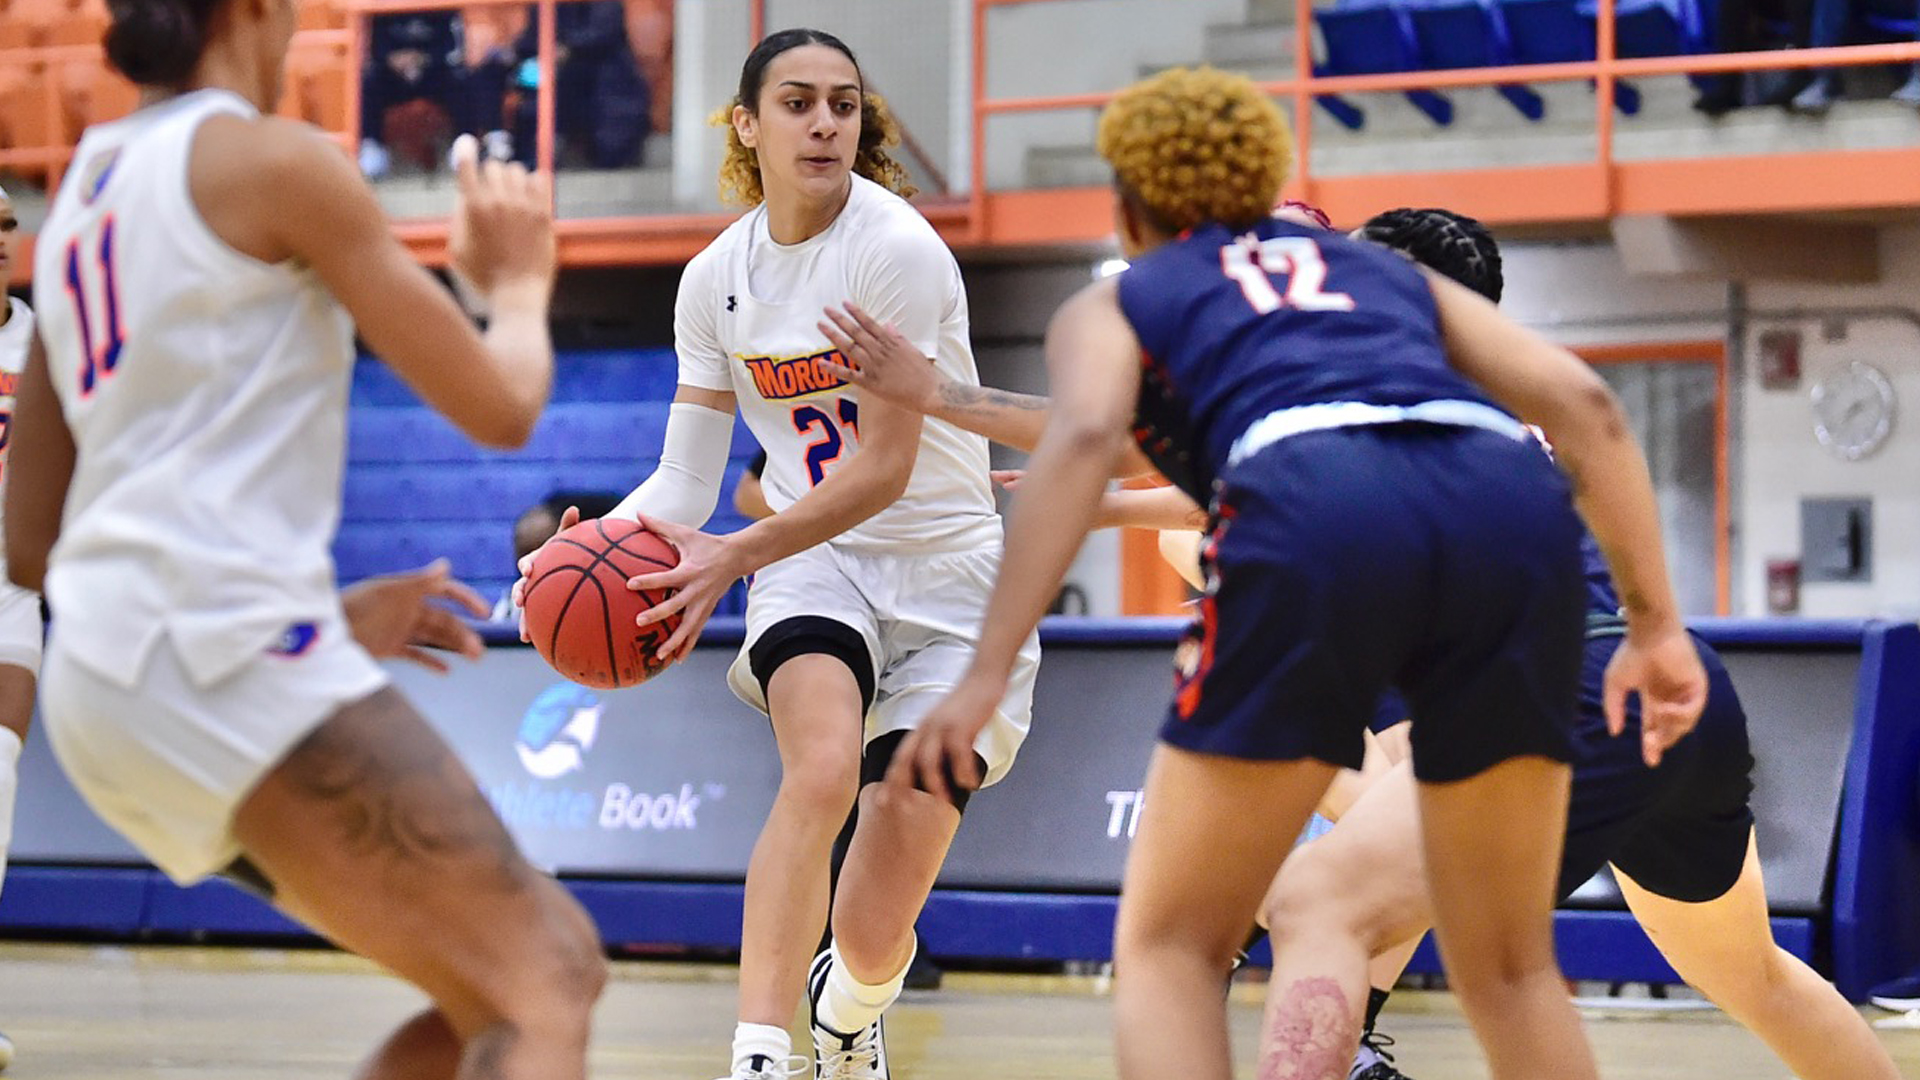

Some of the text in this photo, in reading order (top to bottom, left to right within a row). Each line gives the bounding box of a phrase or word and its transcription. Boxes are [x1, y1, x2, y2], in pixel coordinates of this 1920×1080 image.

[64, 212, 127, 396] 11
[1218, 233, 1356, 316] 12
[746, 350, 857, 398] MORGA
[790, 398, 859, 489] 2
[599, 782, 701, 829] Book
